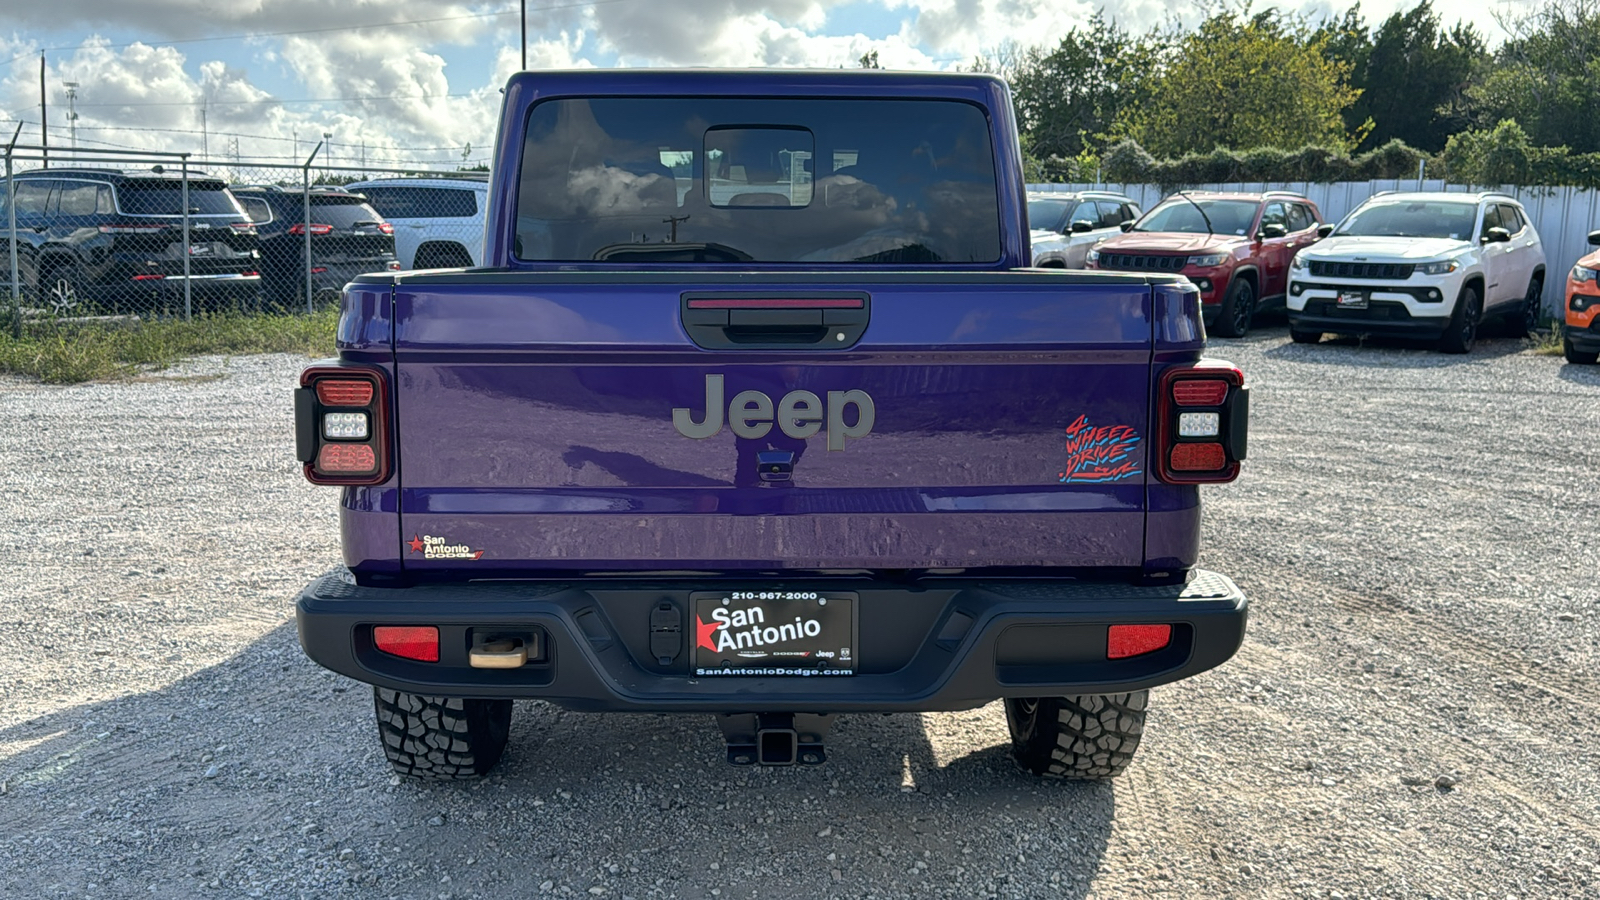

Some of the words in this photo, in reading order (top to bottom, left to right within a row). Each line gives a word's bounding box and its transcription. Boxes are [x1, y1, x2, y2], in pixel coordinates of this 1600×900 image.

[672, 374, 875, 451] Jeep
[1066, 414, 1089, 436] 4
[1066, 425, 1136, 454] WHEEL
[1066, 444, 1131, 477] DRIVE
[423, 535, 445, 544] San
[424, 543, 469, 554] Antonio
[732, 592, 817, 600] 210-967-2000
[712, 606, 764, 630] San
[717, 616, 821, 653] Antonio
[815, 650, 835, 658] Jeep
[696, 668, 853, 676] SanAntonioDodge.com
